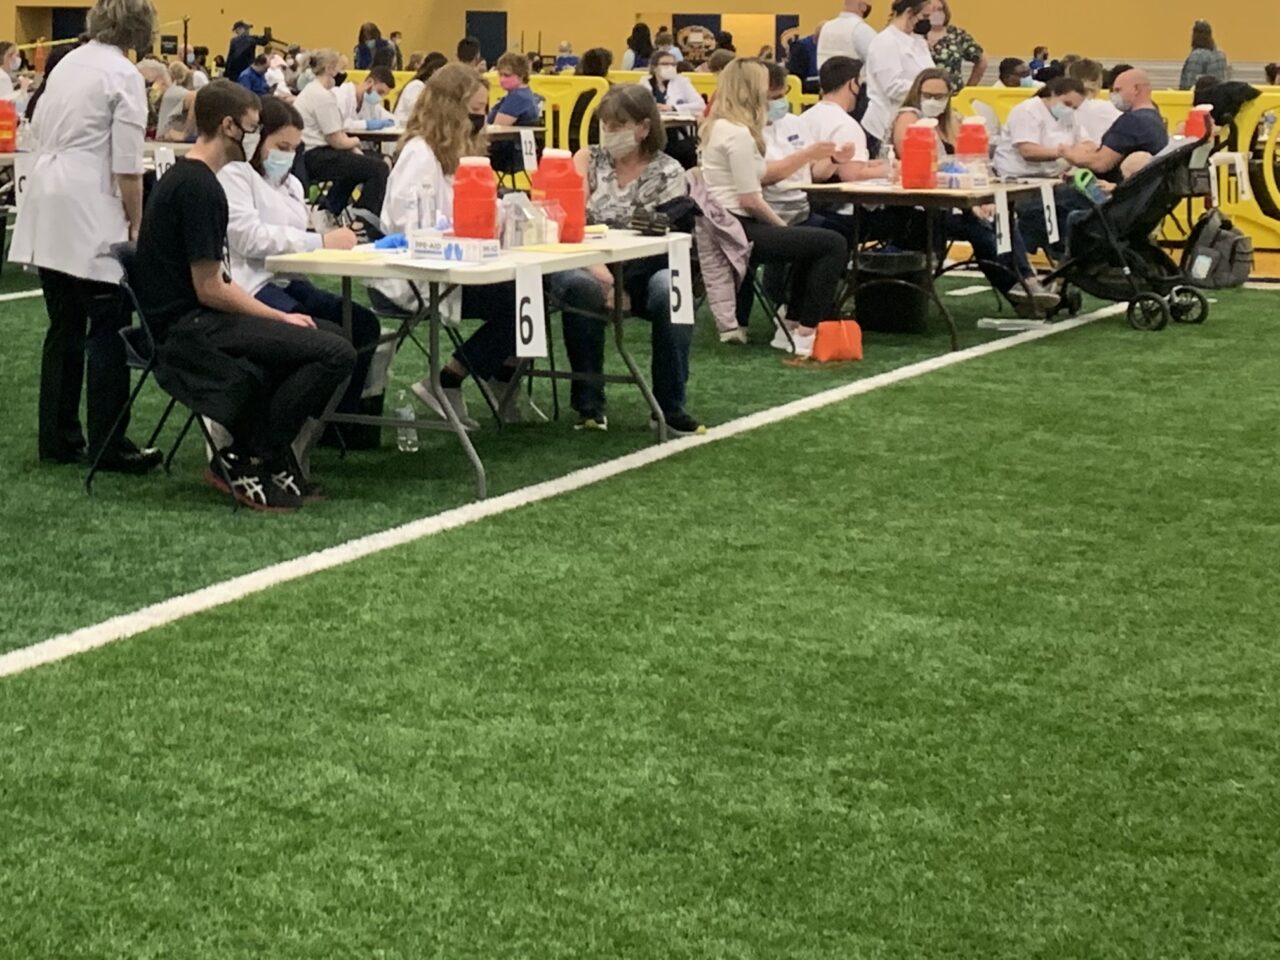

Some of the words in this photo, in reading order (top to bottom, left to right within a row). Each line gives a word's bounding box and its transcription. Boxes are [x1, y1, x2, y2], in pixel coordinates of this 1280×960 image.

[524, 140, 534, 156] 12
[671, 269, 682, 313] 5
[520, 296, 534, 346] 6
